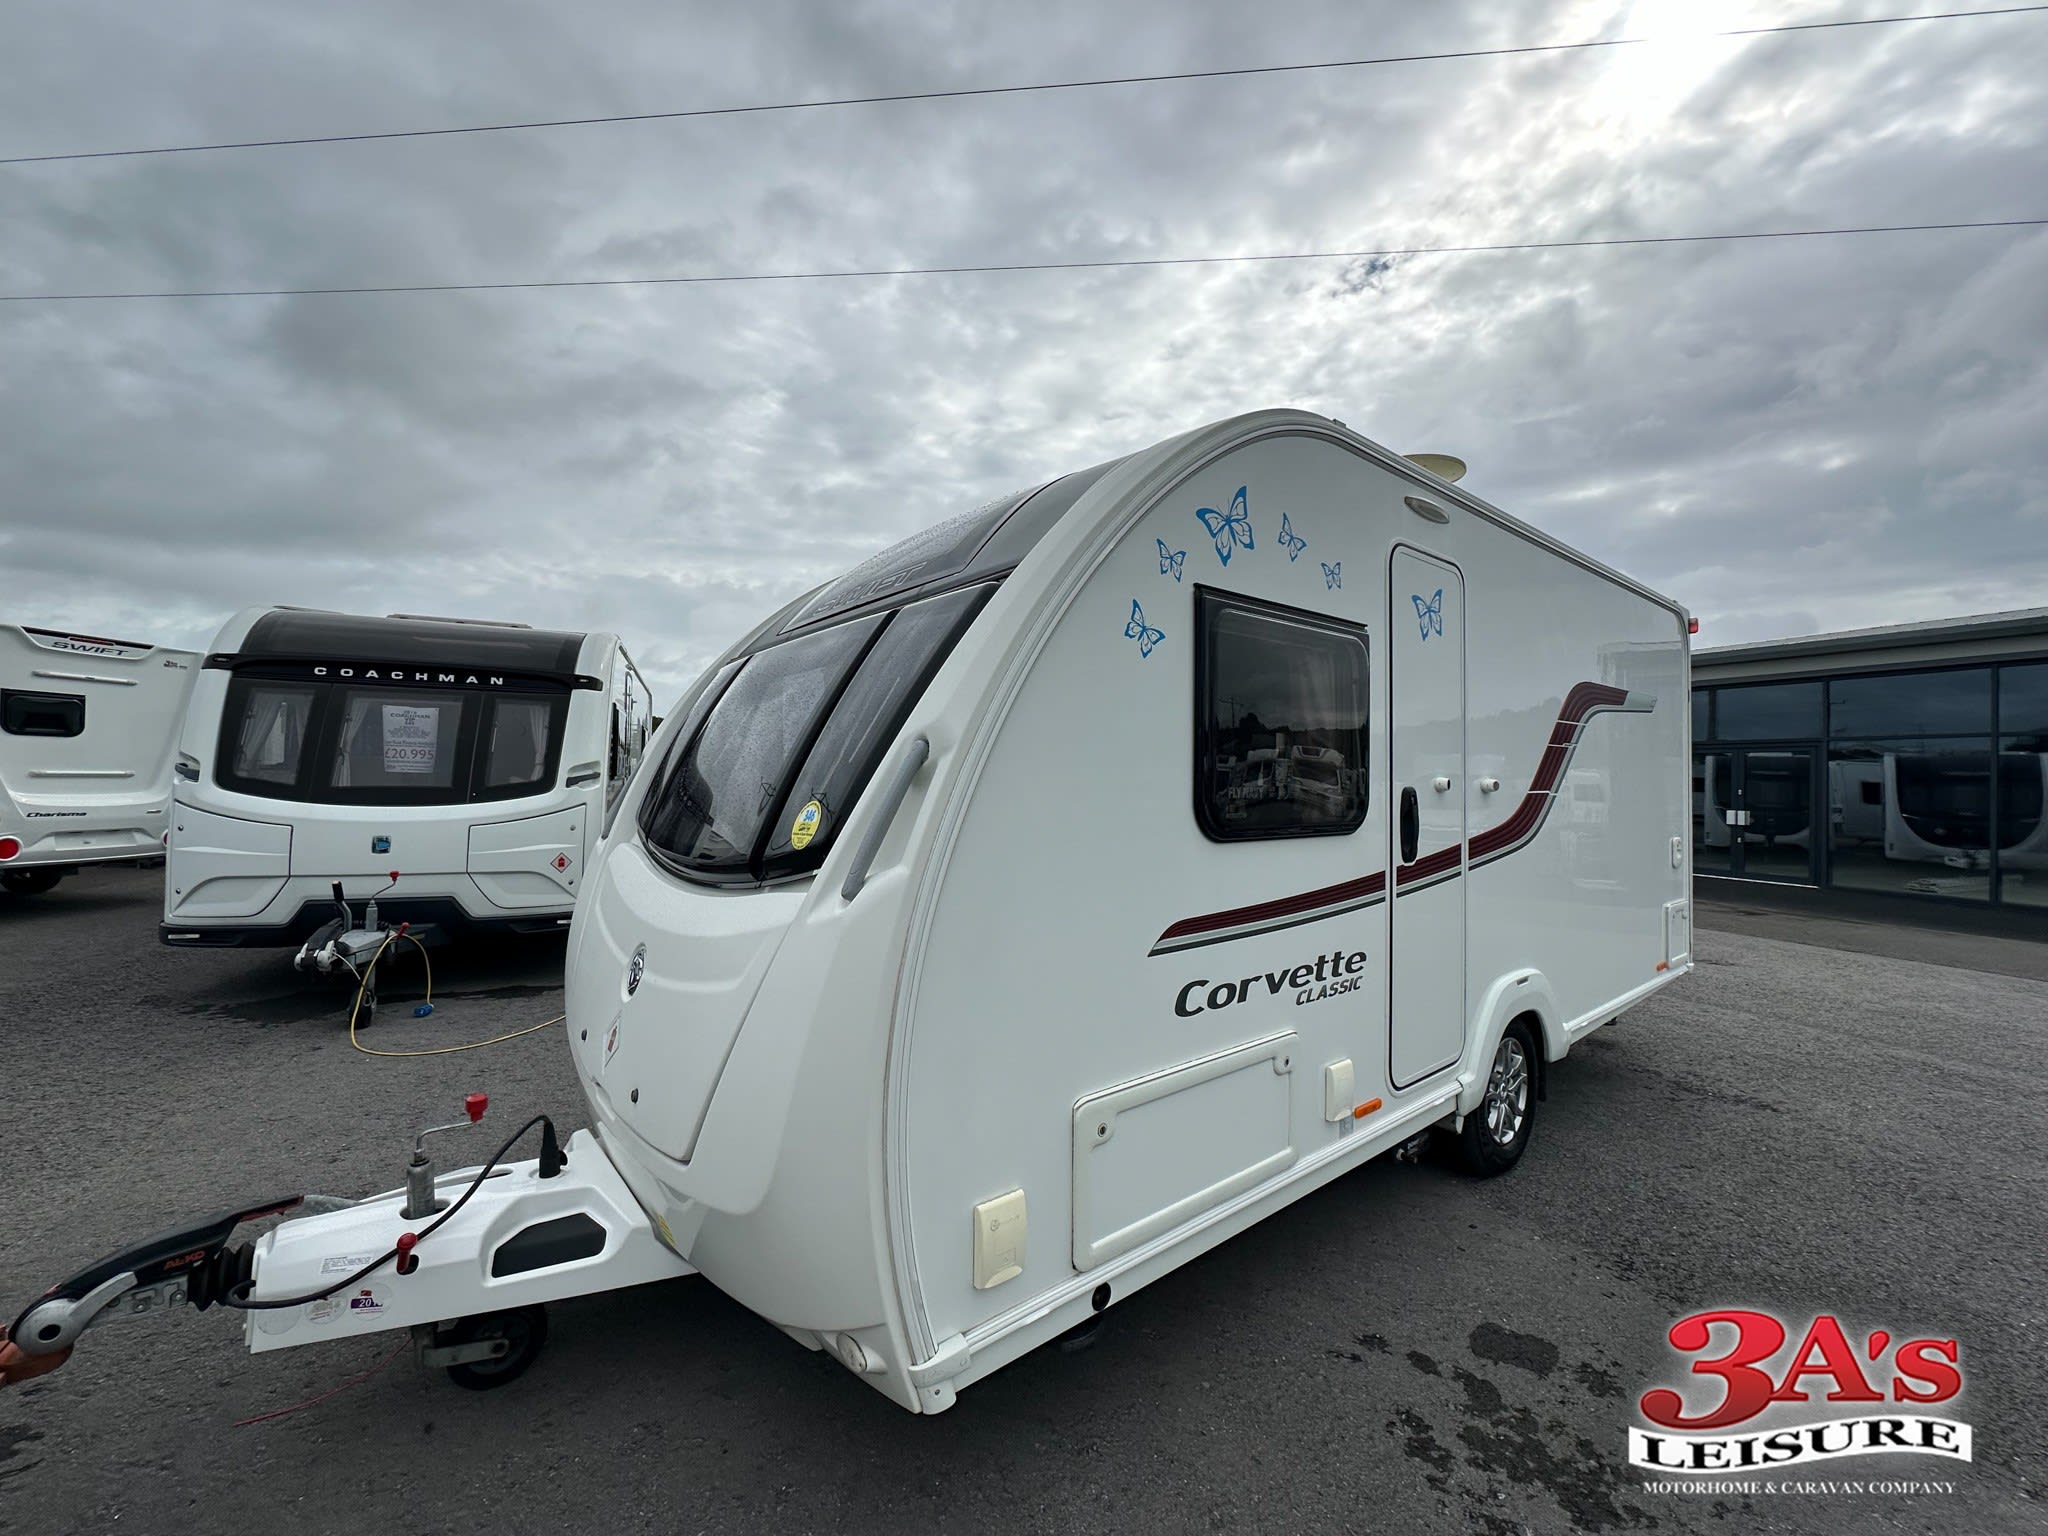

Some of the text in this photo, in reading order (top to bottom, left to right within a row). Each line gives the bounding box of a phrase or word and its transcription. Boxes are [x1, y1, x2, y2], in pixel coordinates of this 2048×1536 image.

[815, 561, 927, 616] SWIFT
[51, 641, 129, 656] SWIFT
[313, 667, 504, 685] COACHMAN
[1174, 951, 1367, 1018] Corvette
[1295, 975, 1364, 1006] CLASSIC
